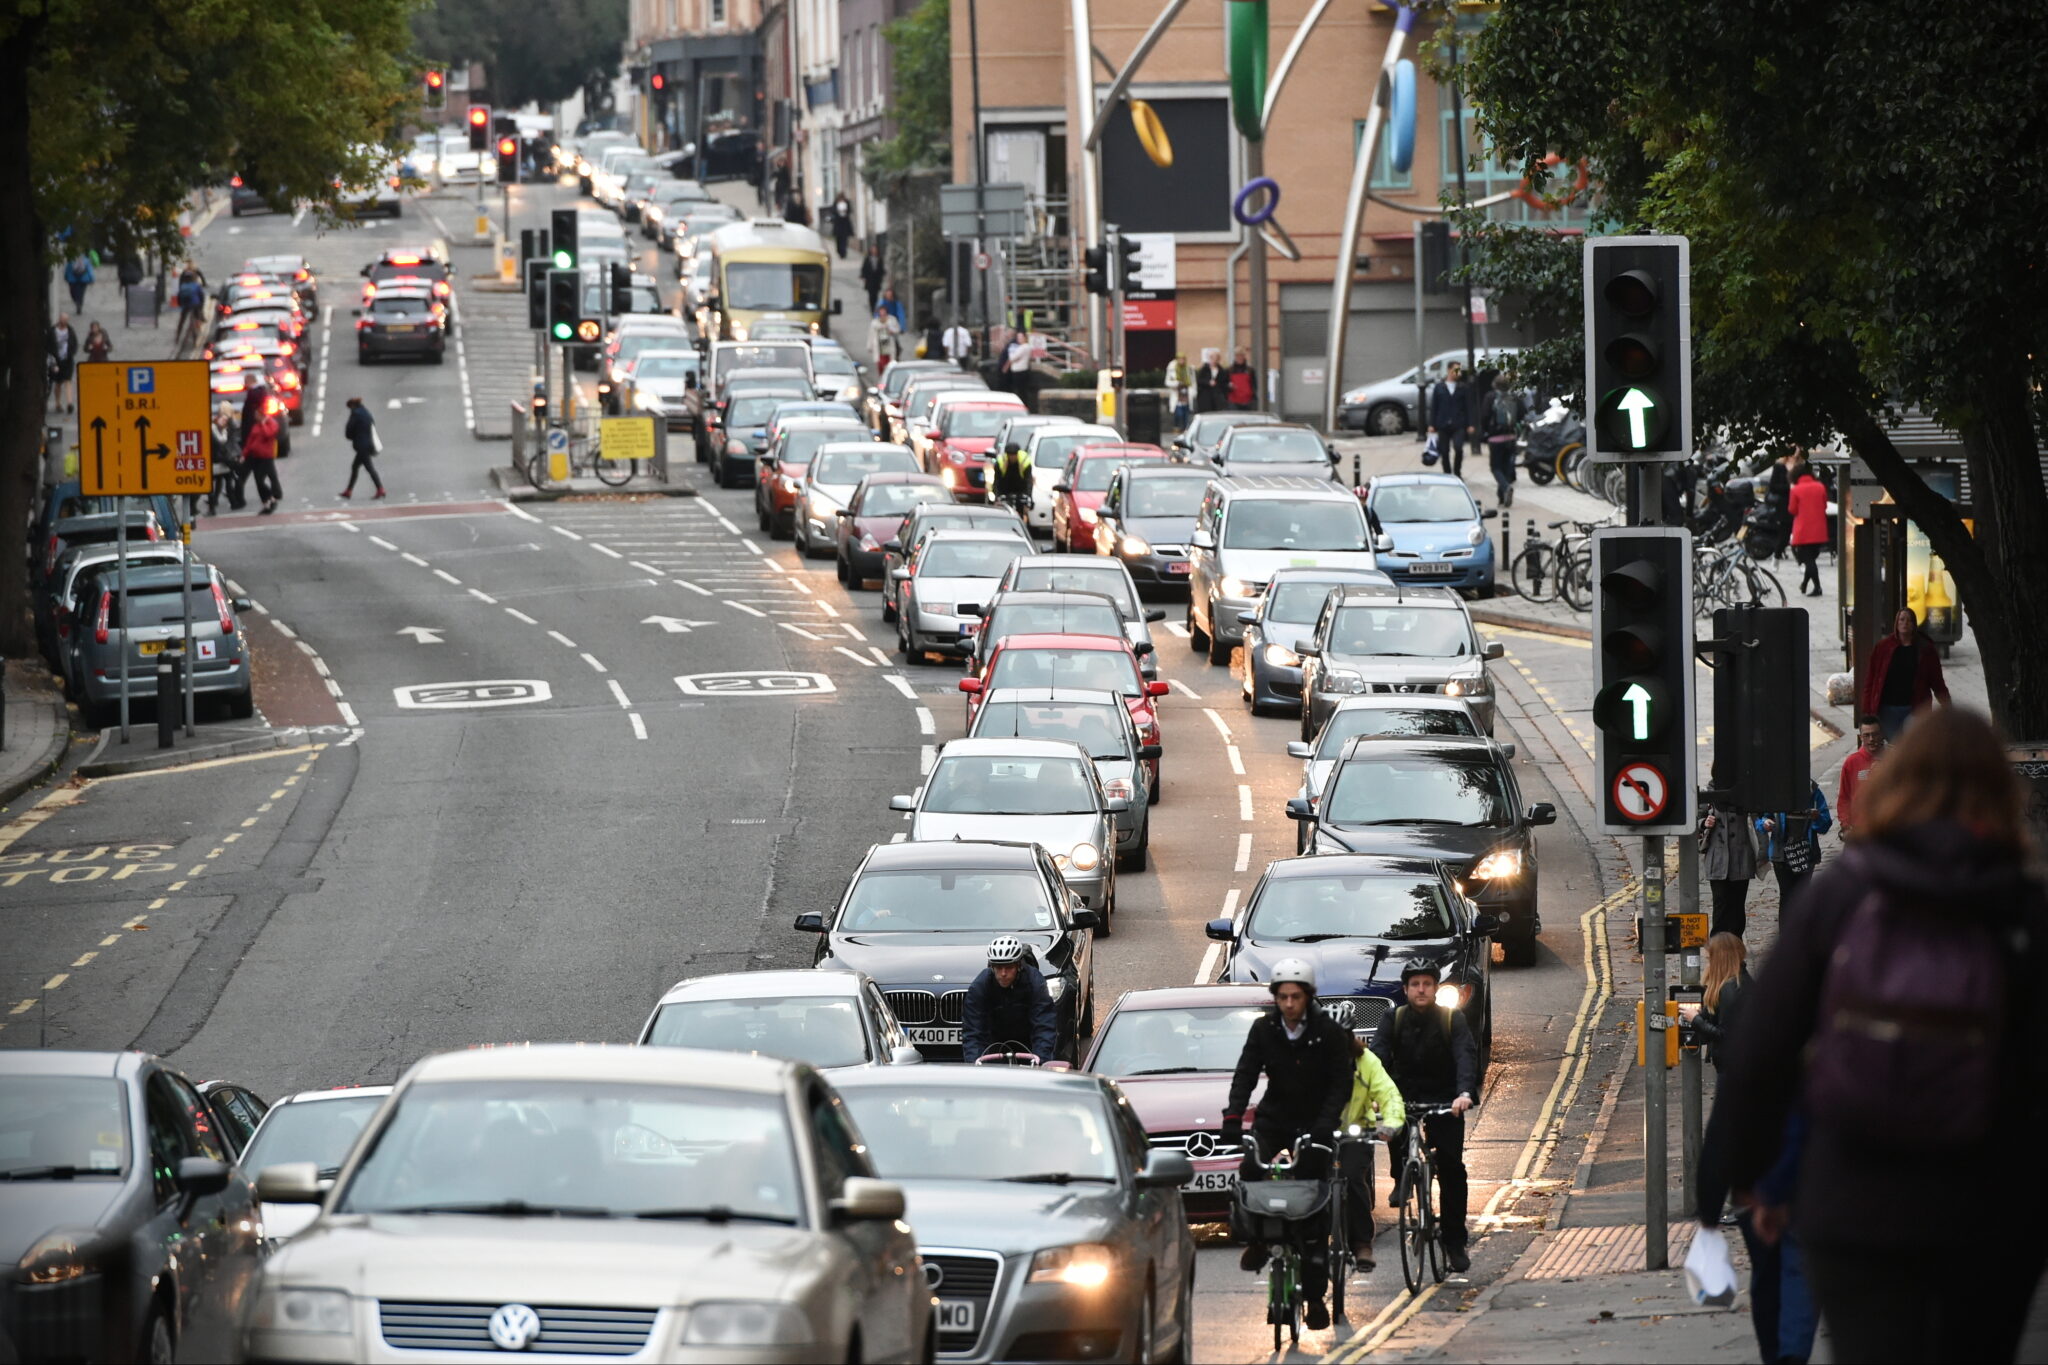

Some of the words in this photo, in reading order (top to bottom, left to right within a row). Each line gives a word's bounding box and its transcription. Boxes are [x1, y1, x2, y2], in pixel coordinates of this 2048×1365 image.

[132, 369, 150, 392] P
[125, 398, 160, 410] B.R.I.
[180, 432, 198, 454] H
[176, 474, 206, 487] only
[201, 646, 211, 655] L
[702, 677, 810, 690] 20
[418, 686, 528, 702] 20
[0, 844, 175, 868] BUS
[0, 863, 178, 887] TOP
[909, 1029, 944, 1042] K400
[1195, 1173, 1236, 1190] 4634
[940, 1304, 969, 1326] WO
